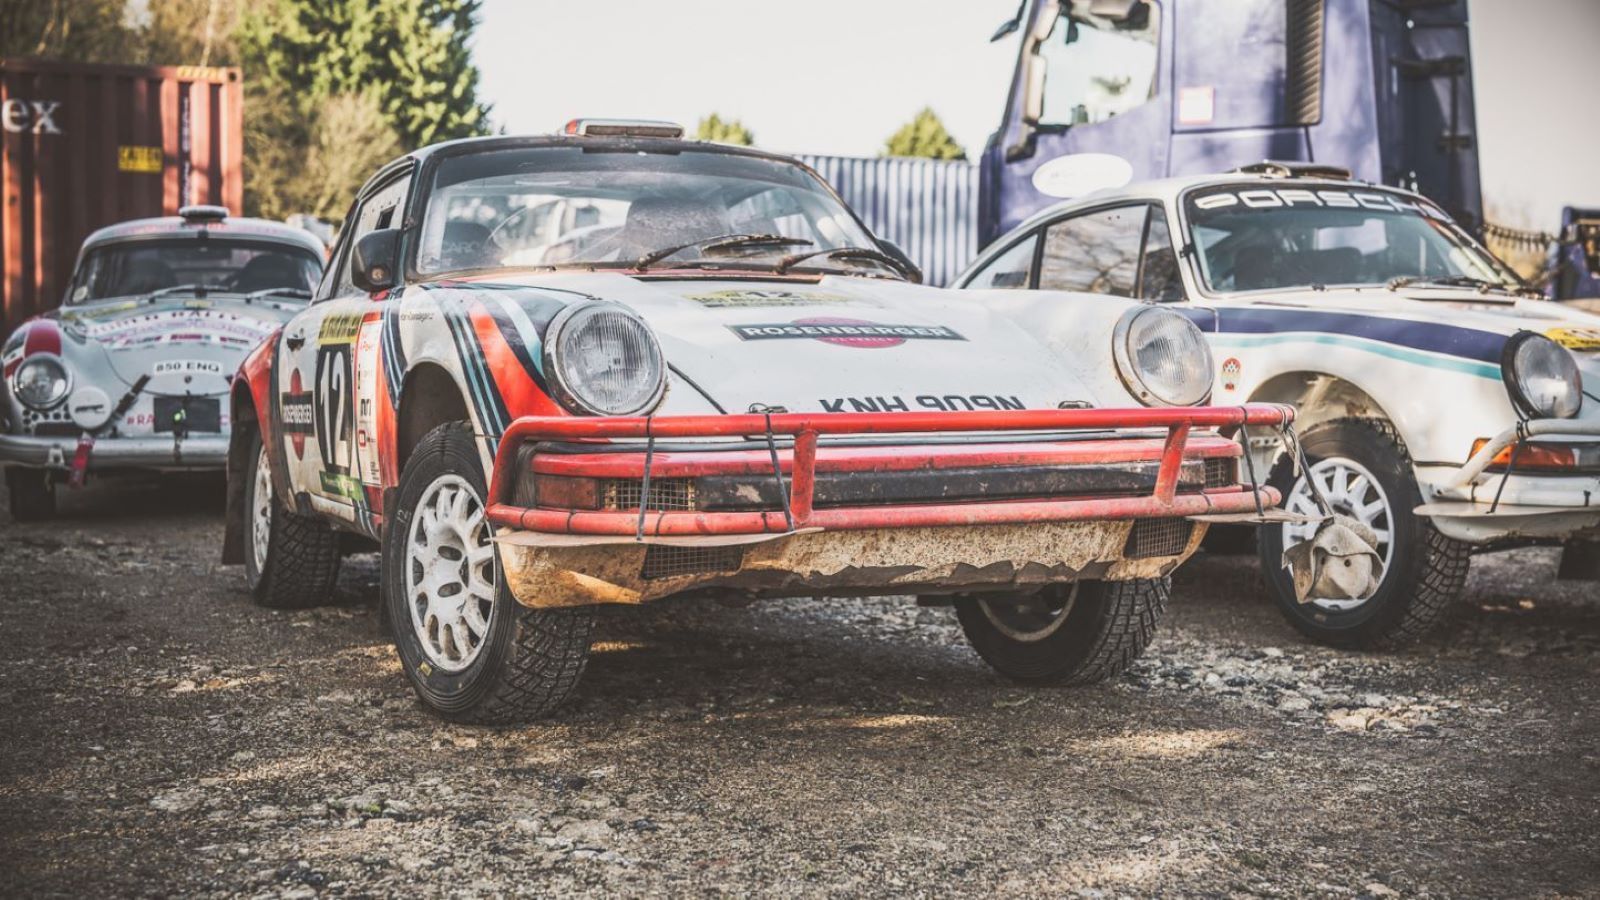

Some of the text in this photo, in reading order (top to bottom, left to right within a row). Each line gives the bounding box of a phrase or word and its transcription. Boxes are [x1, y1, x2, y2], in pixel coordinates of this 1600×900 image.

[1194, 190, 1436, 217] PORSCH
[741, 325, 951, 337] ROSENBERGER
[319, 351, 349, 468] 12
[818, 395, 1027, 412] KNH 909N
